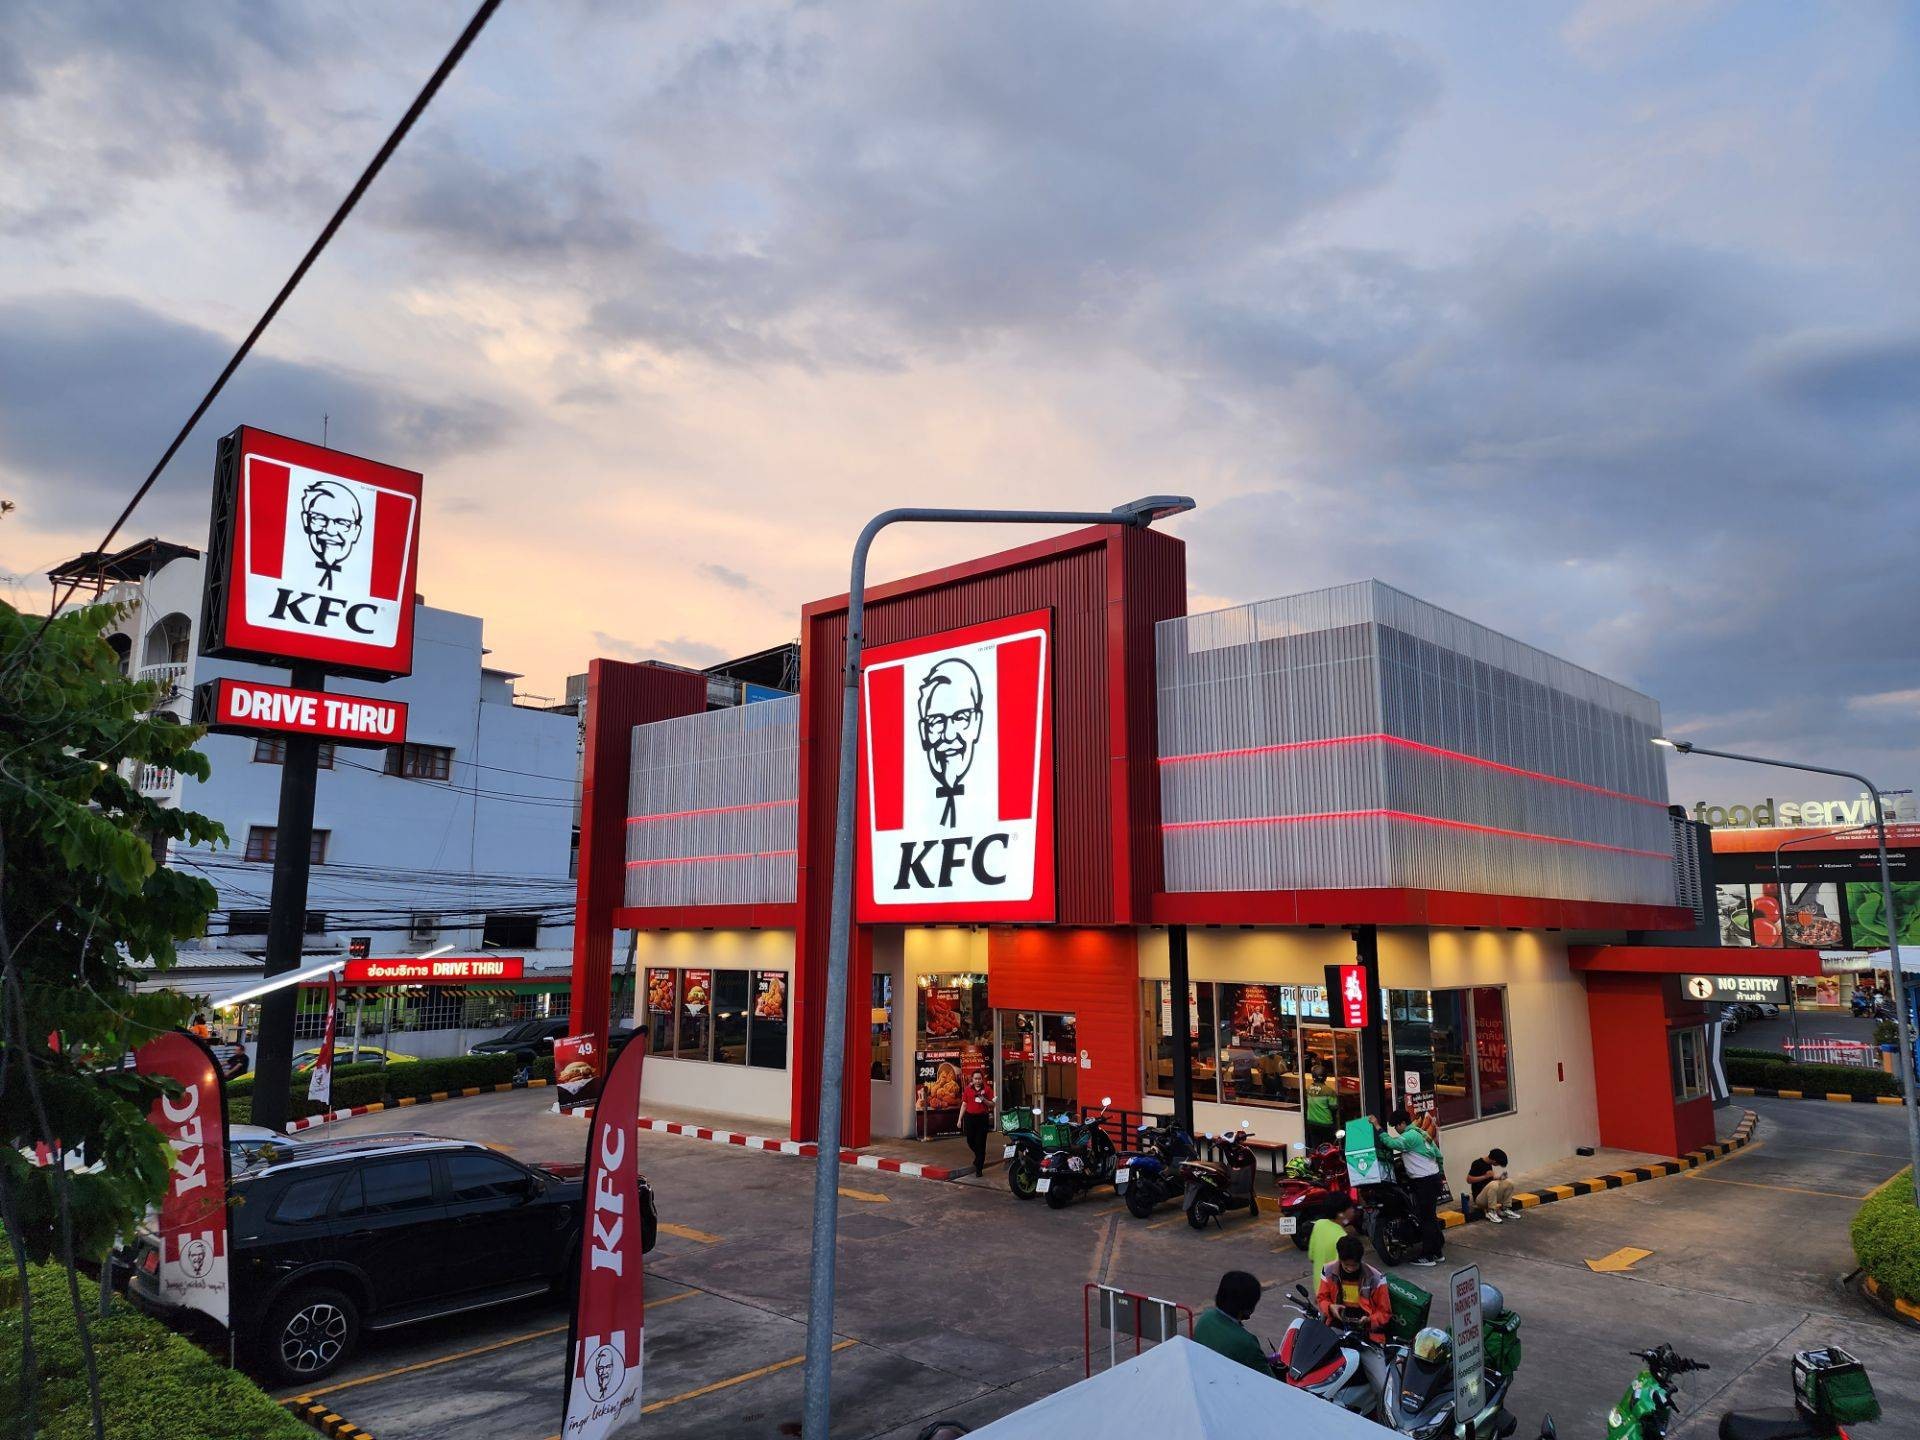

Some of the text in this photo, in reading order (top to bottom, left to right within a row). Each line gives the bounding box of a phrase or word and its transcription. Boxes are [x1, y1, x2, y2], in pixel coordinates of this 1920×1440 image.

[268, 587, 378, 634] KFC
[231, 687, 395, 734] DRIVE THRU
[1693, 792, 1918, 826] food service
[893, 832, 1010, 889] KFC
[367, 962, 504, 977] ช่องบริการ DRIVE THRU
[1718, 978, 1779, 991] NO ENTRY
[1306, 989, 1319, 1002] UP
[1736, 991, 1766, 1001] ห้ามเข้า
[591, 1122, 625, 1277] KFC
